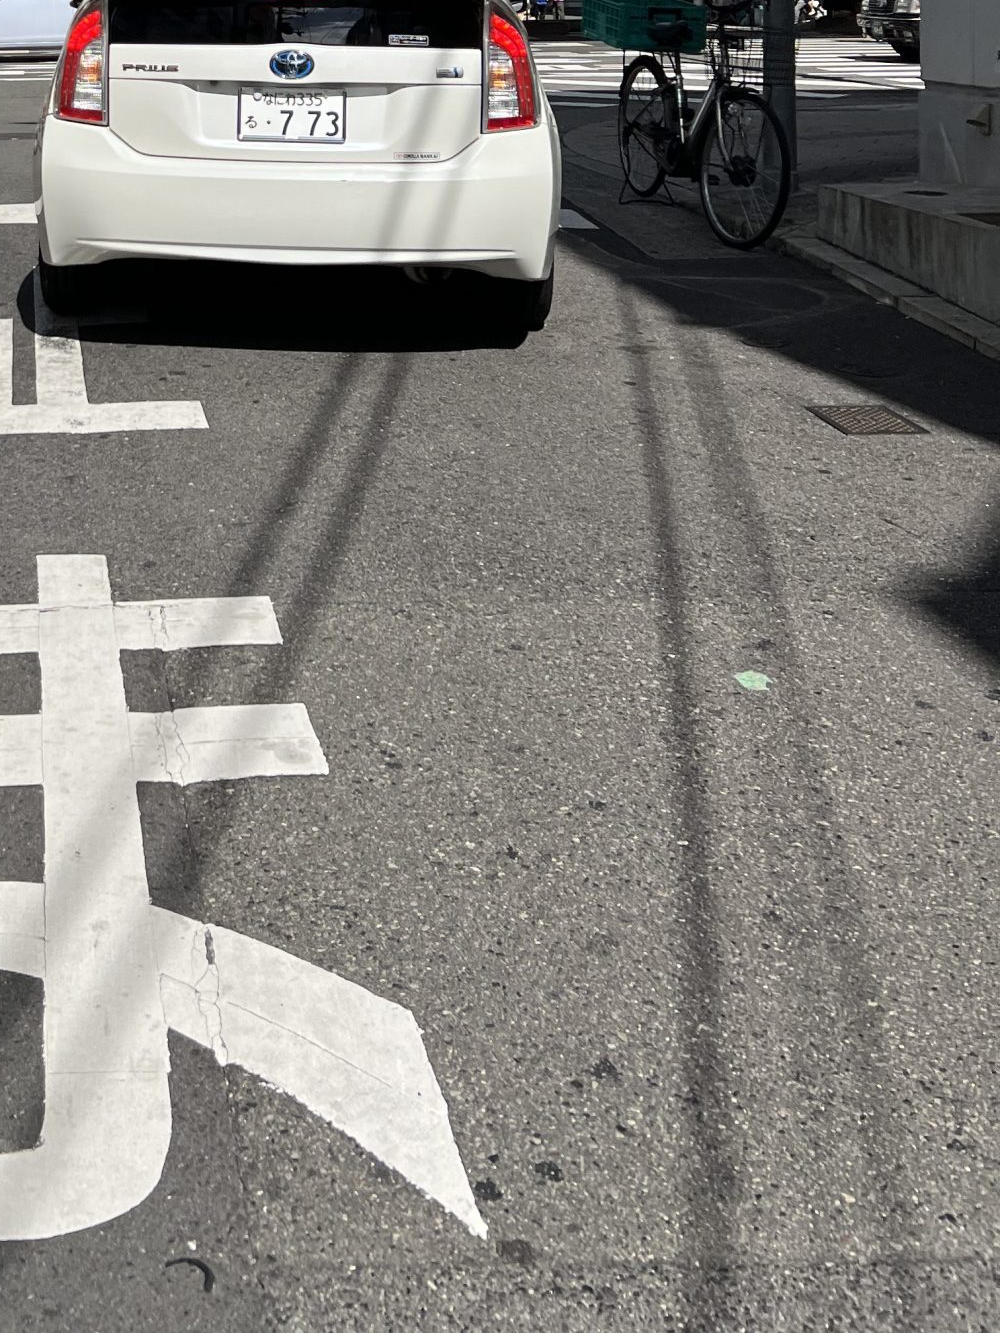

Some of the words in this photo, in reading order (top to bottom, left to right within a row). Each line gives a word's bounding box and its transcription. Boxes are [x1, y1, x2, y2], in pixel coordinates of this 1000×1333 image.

[122, 63, 179, 73] PRIUS
[263, 92, 296, 106] なにわ
[296, 92, 323, 107] 335
[245, 115, 258, 129] る
